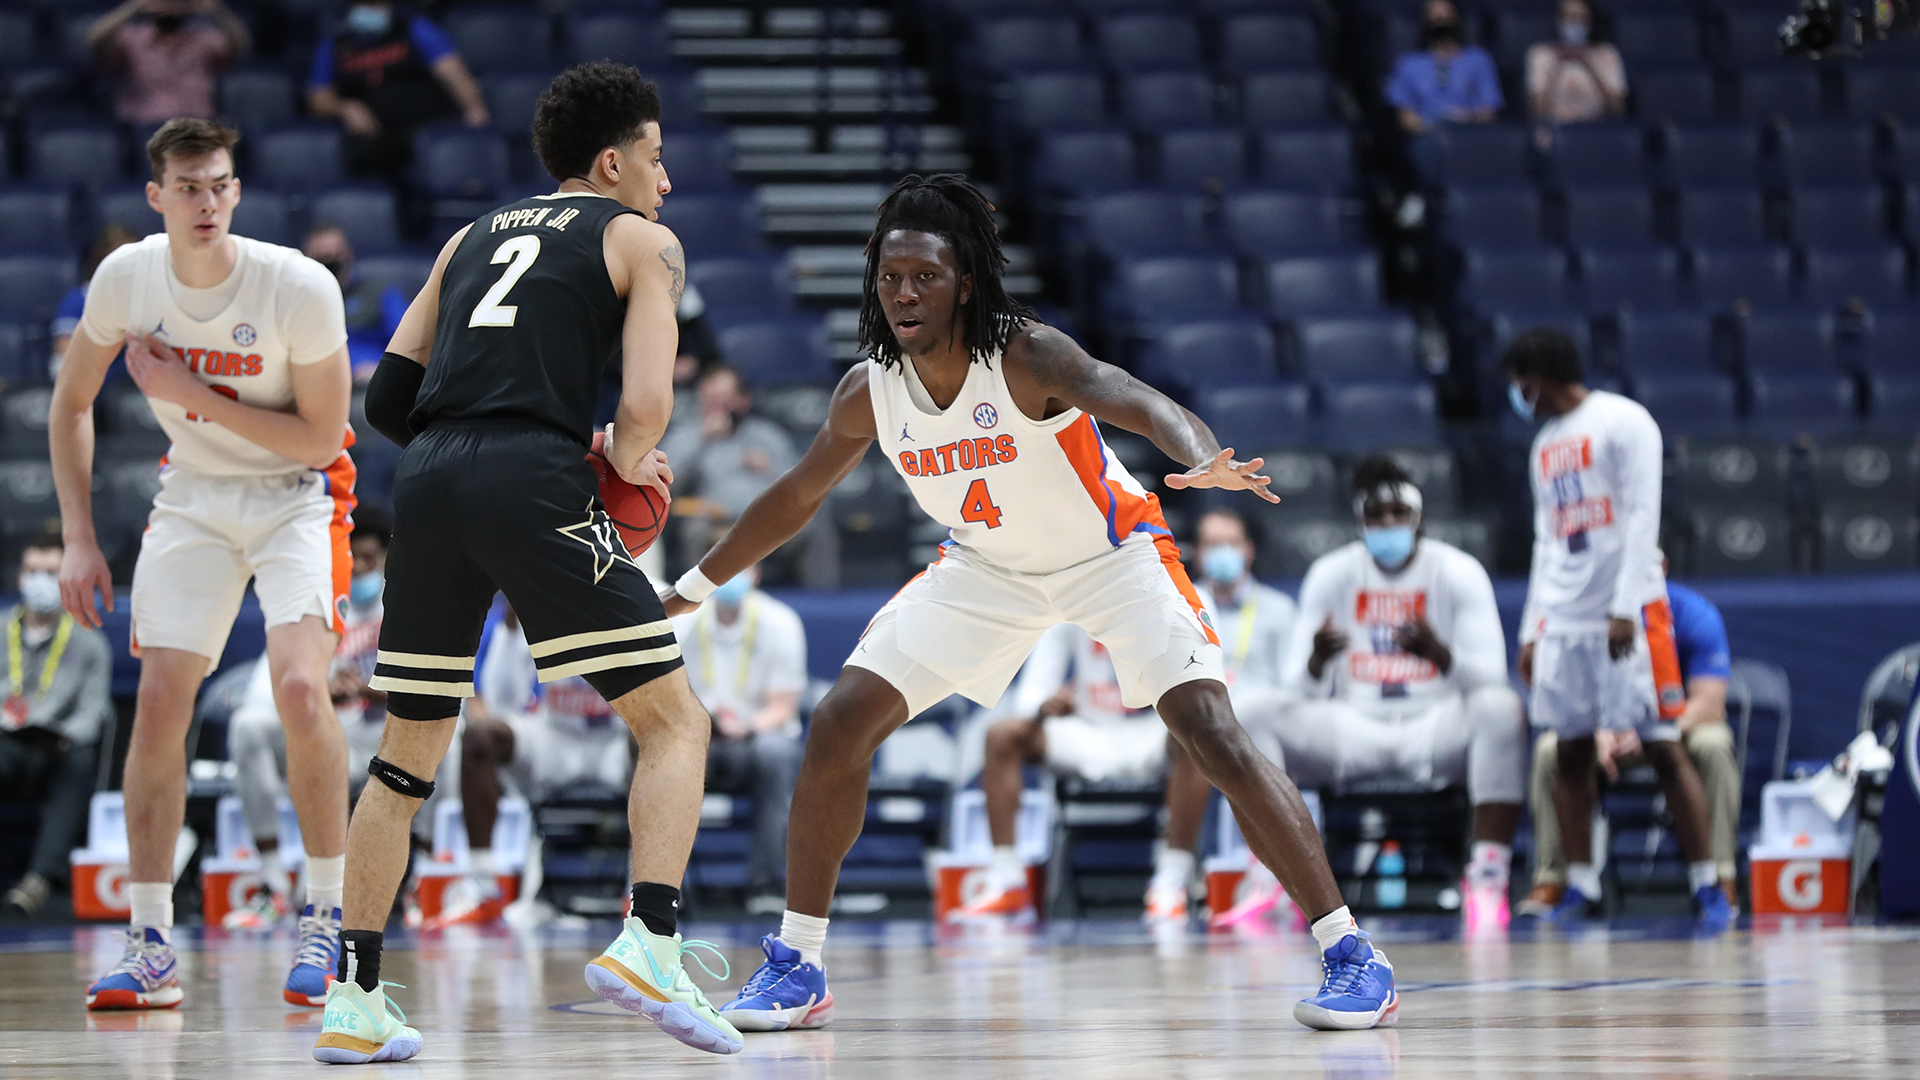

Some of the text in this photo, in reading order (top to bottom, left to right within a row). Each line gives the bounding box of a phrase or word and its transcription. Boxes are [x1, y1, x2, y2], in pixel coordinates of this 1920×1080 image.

[489, 207, 581, 233] PIPPEN JR.
[468, 234, 541, 328] 2
[168, 346, 264, 377] TORS
[974, 403, 997, 428] SEC
[898, 433, 1018, 477] GATORS
[960, 477, 1003, 530] 4
[590, 520, 614, 553] V
[1778, 861, 1823, 910] G
